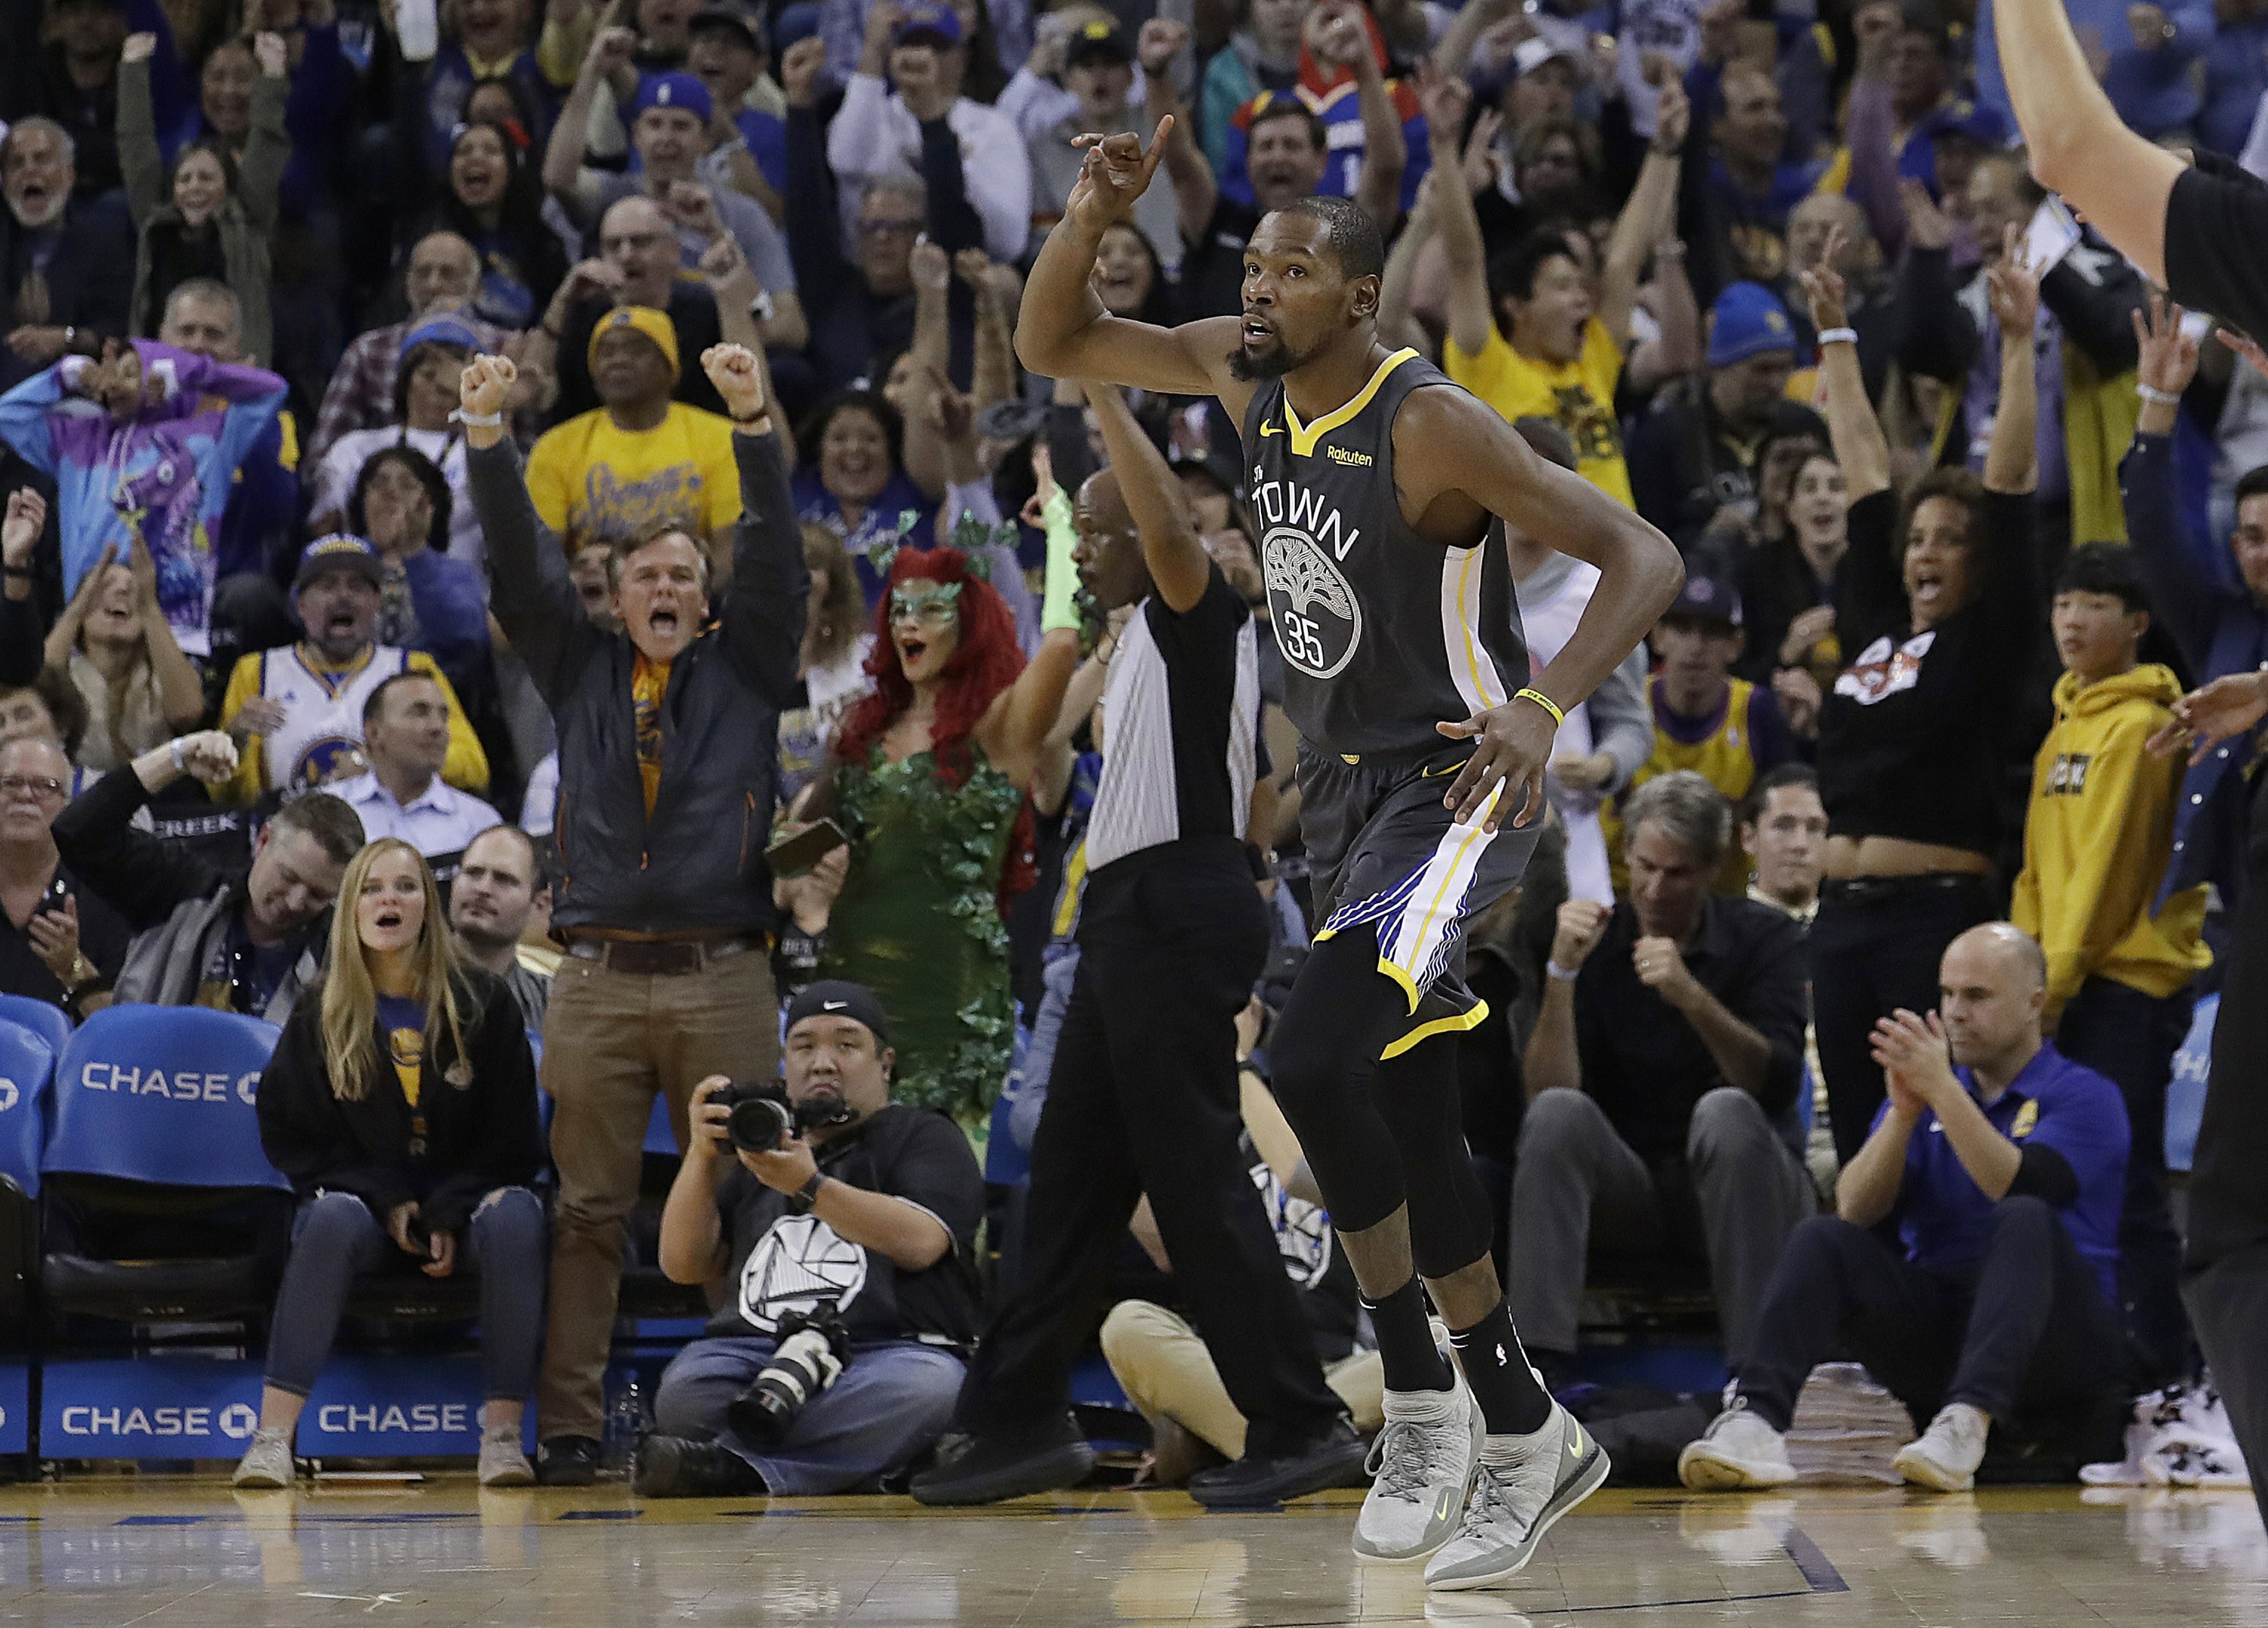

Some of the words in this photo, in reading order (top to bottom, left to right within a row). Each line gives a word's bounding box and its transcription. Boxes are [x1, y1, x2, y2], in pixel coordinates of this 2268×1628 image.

[1327, 445, 1372, 466] Rakuten
[1251, 481, 1360, 562] TOWN
[1284, 610, 1324, 668] 35
[82, 1062, 229, 1102] CHASE
[62, 1406, 212, 1435] CHASE
[319, 1404, 468, 1433] CHASE
